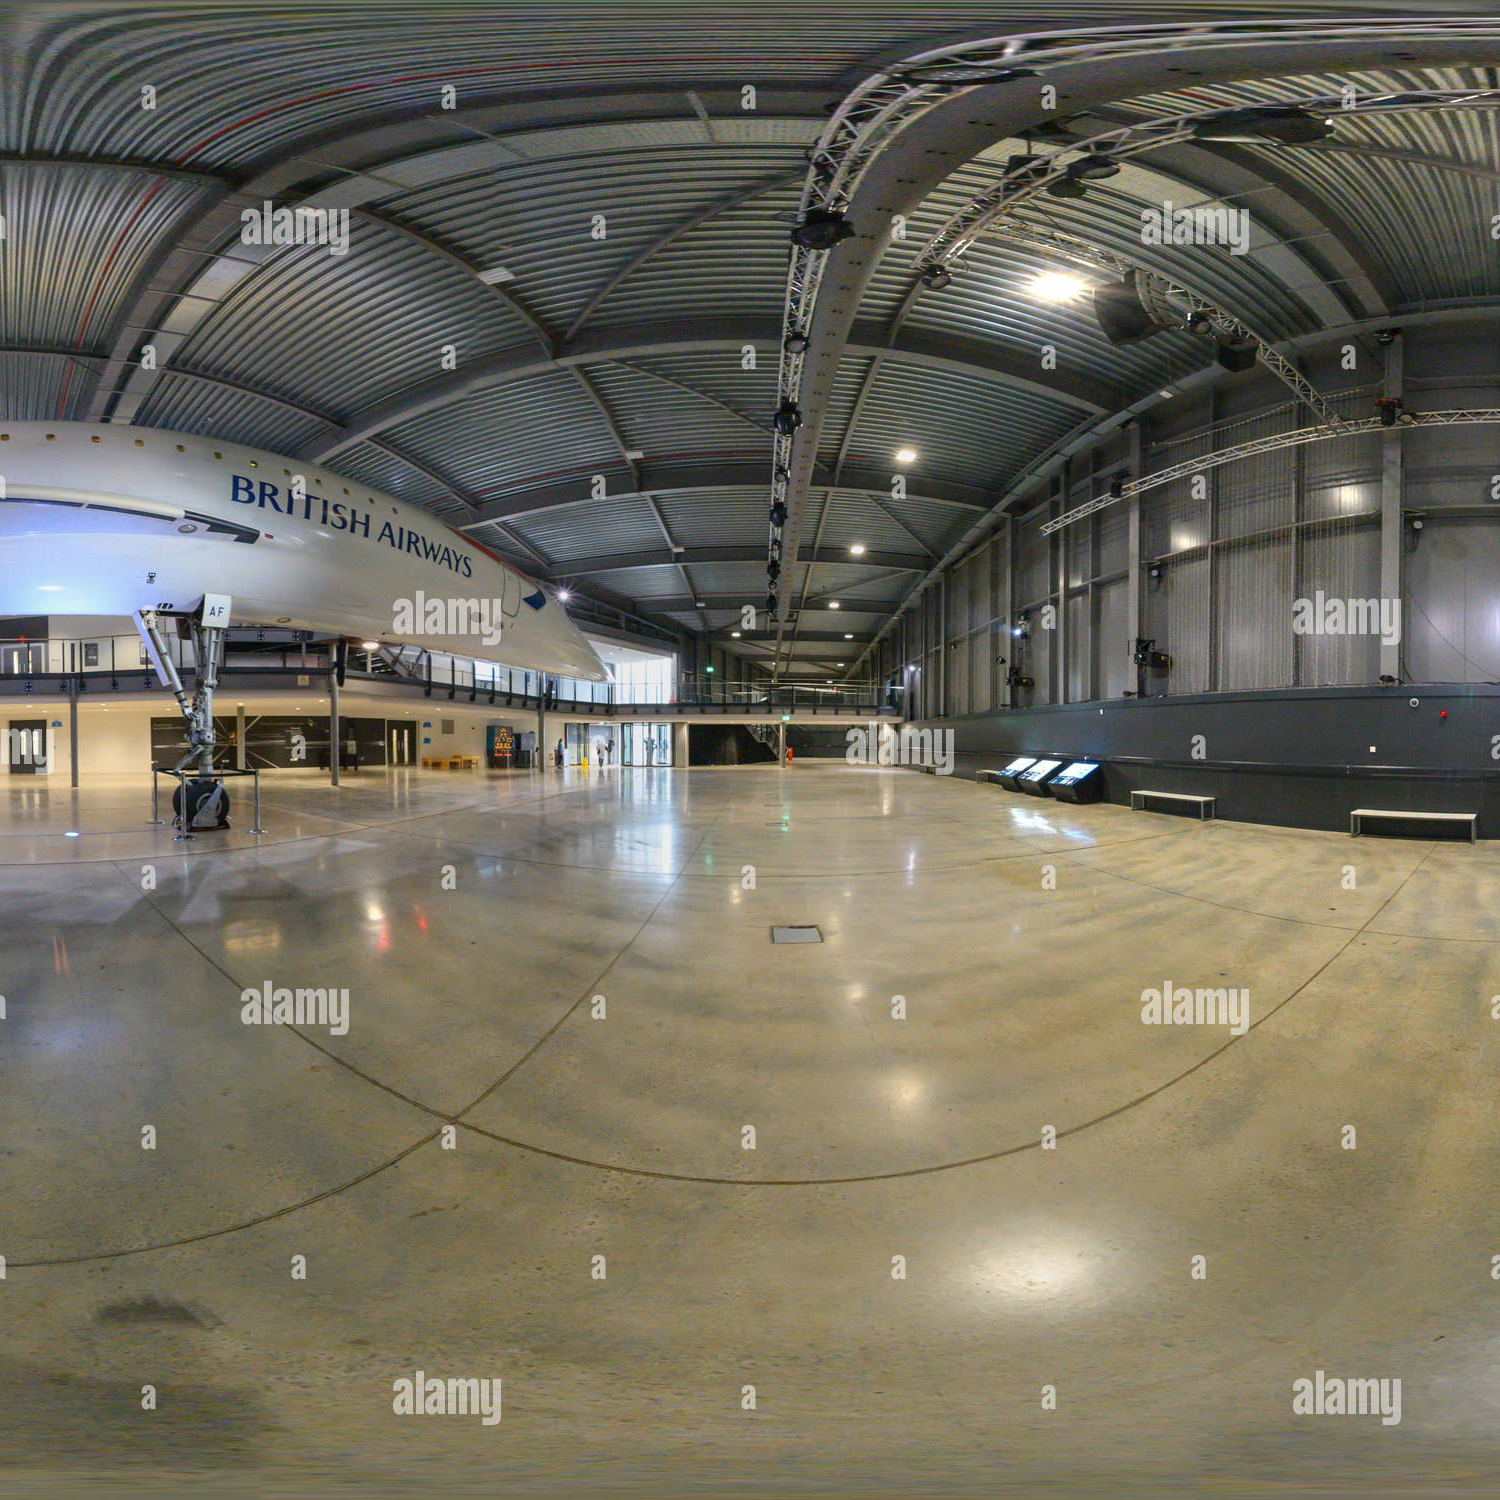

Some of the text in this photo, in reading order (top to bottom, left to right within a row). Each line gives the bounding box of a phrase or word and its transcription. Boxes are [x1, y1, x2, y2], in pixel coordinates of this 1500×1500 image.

[230, 474, 473, 579] BRITISH AIRWAYS
[209, 606, 225, 618] AF
